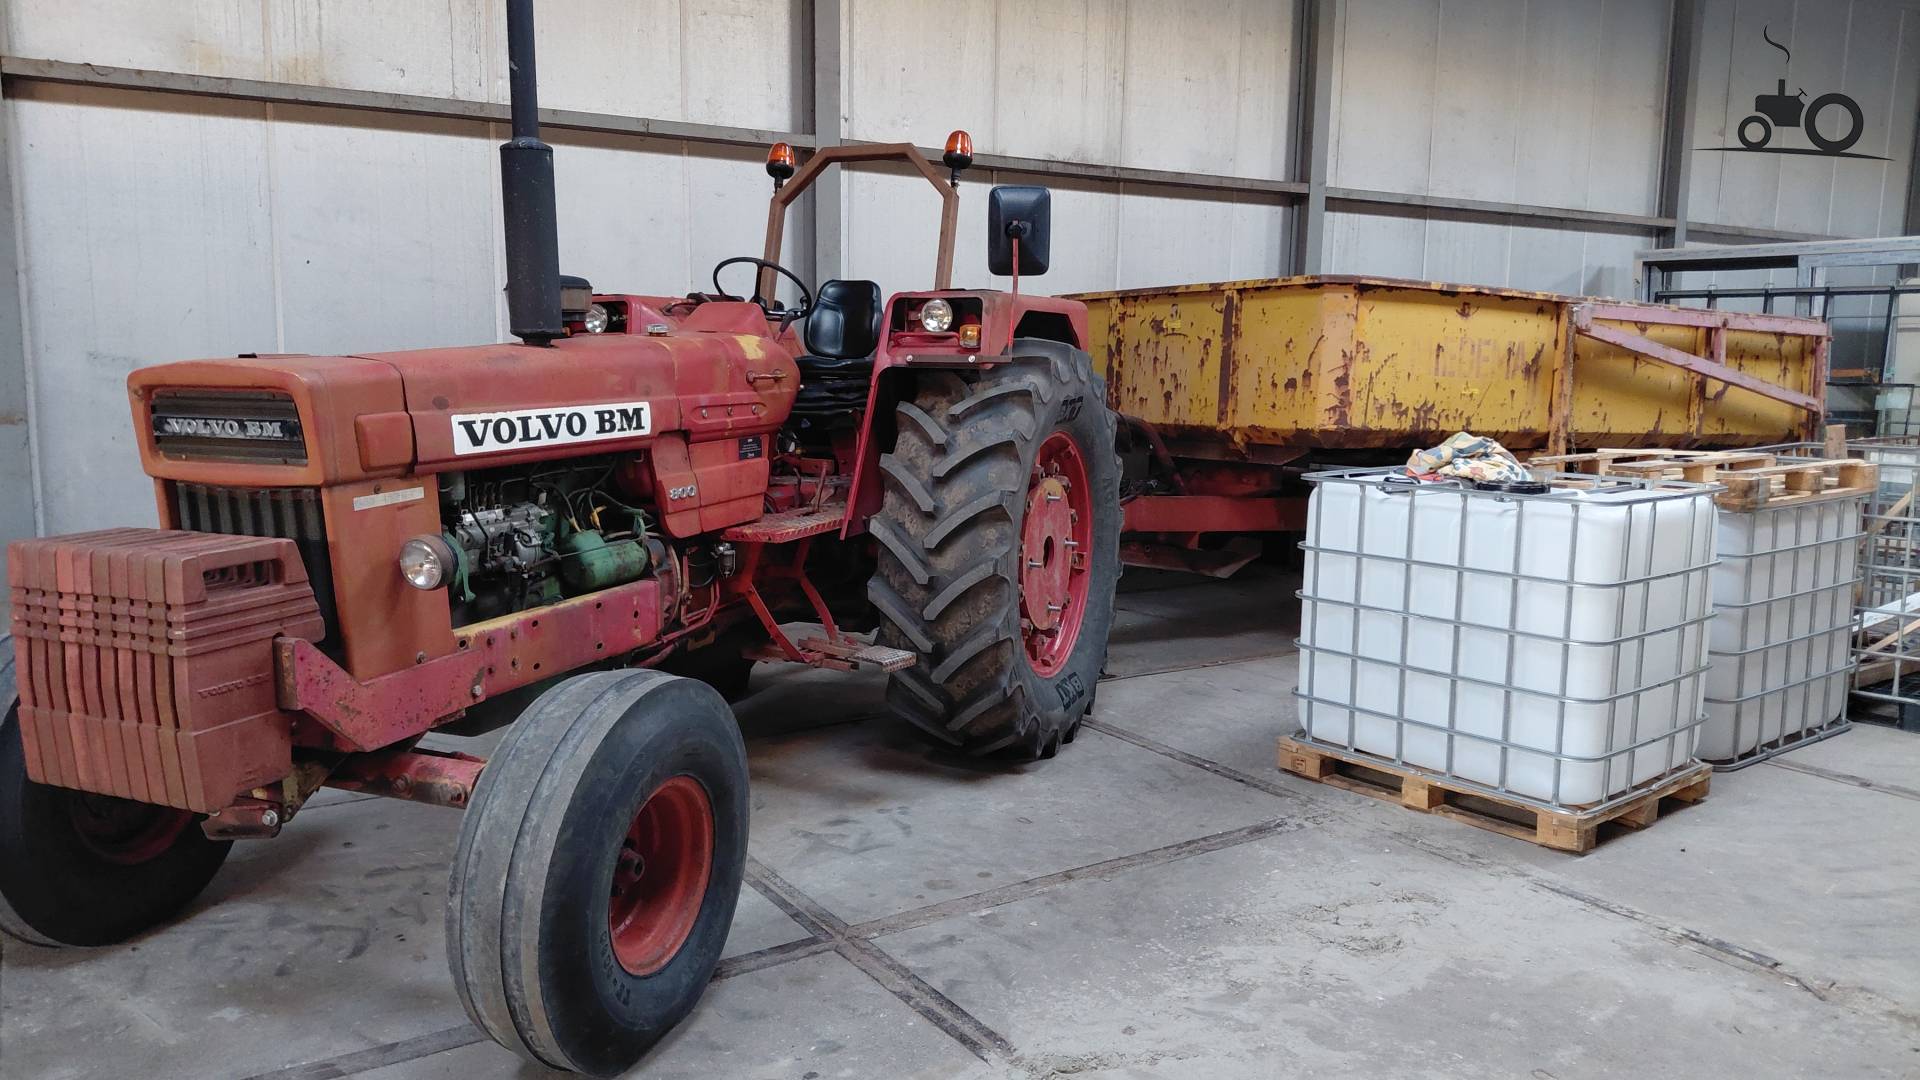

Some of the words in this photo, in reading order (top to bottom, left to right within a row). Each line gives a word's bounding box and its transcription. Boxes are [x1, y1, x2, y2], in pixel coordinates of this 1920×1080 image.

[164, 417, 240, 436] VOLVO
[244, 421, 283, 438] BM
[458, 412, 587, 447] VOLVO
[595, 407, 645, 434] BM
[669, 484, 697, 500] 800
